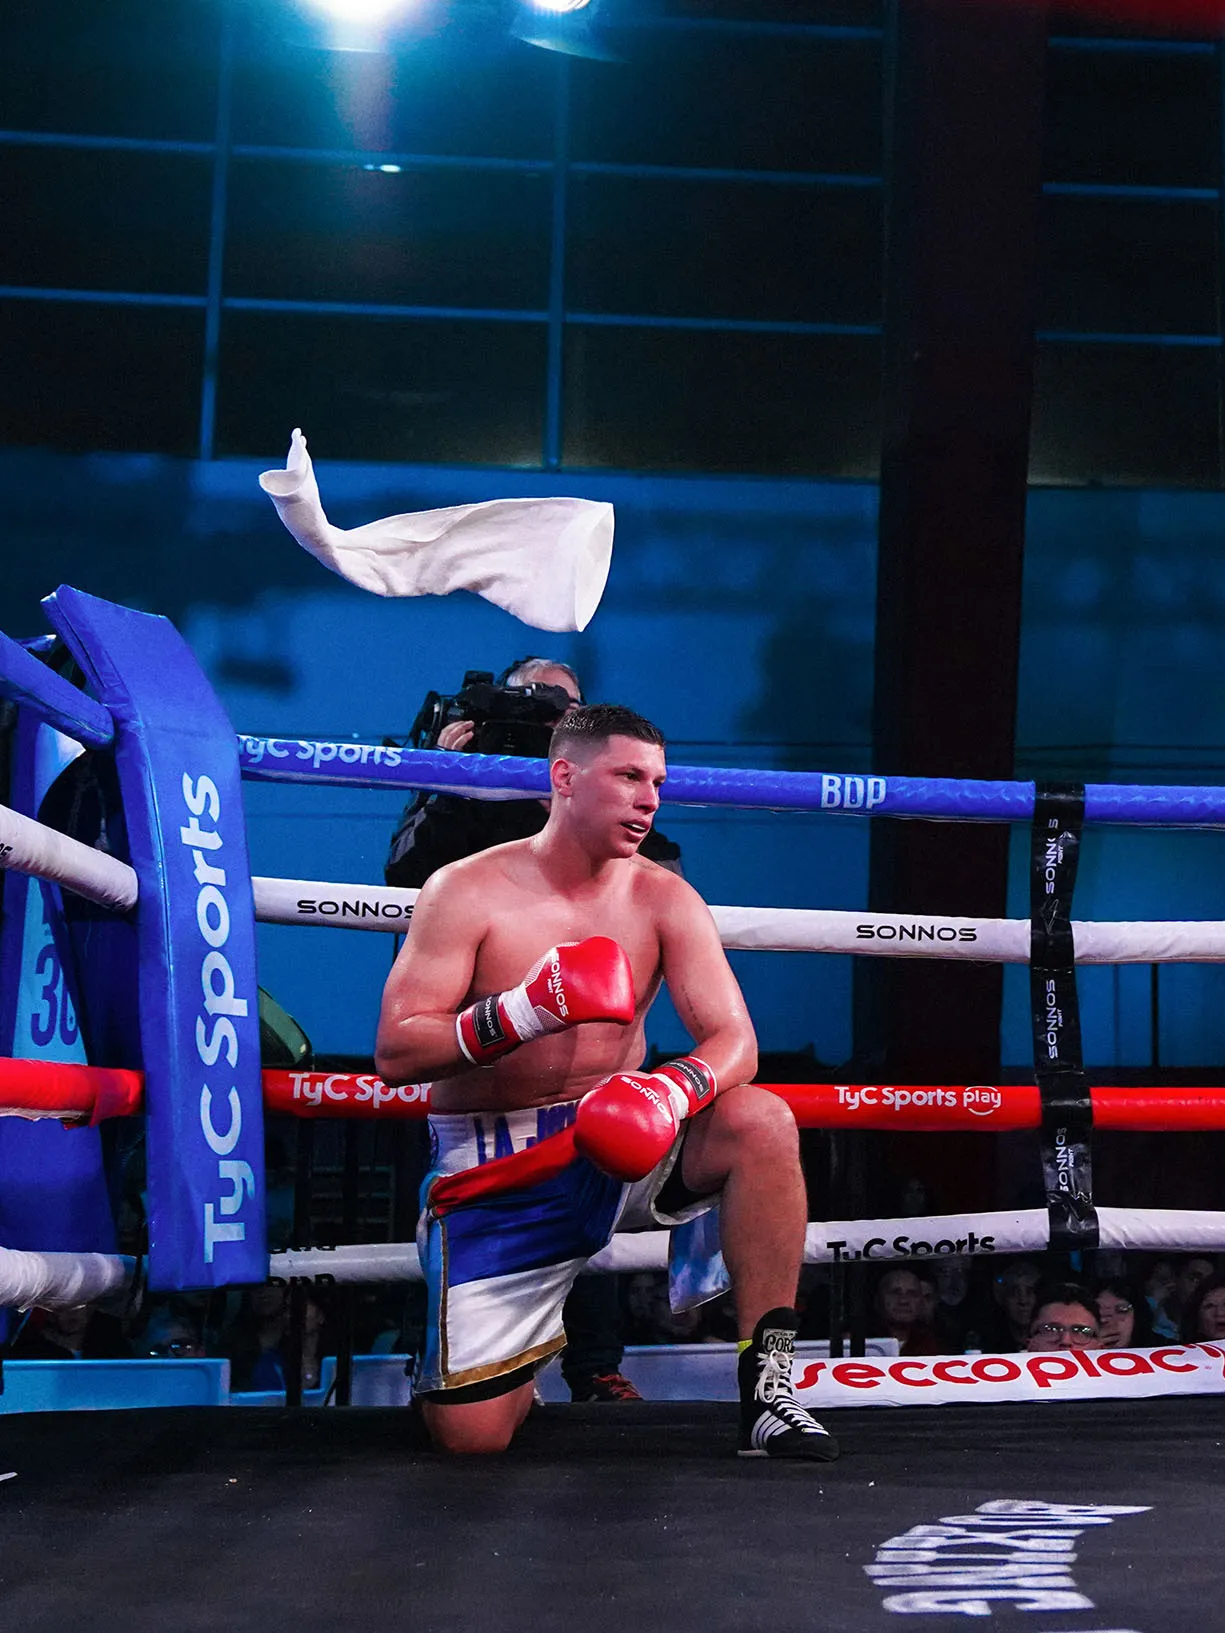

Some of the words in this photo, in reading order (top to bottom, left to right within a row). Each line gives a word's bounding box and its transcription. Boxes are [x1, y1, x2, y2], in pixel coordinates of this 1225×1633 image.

[821, 774, 887, 809] BDP
[179, 771, 249, 1069] Sports
[296, 899, 415, 919] SONNOS
[856, 923, 978, 942] SONNOS
[1045, 978, 1059, 1060] SONNOS
[288, 1072, 350, 1106] TyC
[354, 1076, 432, 1109] Spor
[834, 1085, 878, 1110] TyC
[881, 1087, 957, 1111] Sports
[962, 1089, 1002, 1108] play
[199, 1083, 256, 1264] TyC
[1055, 1127, 1070, 1192] SONNOS
[795, 1347, 1199, 1389] seccoplac
